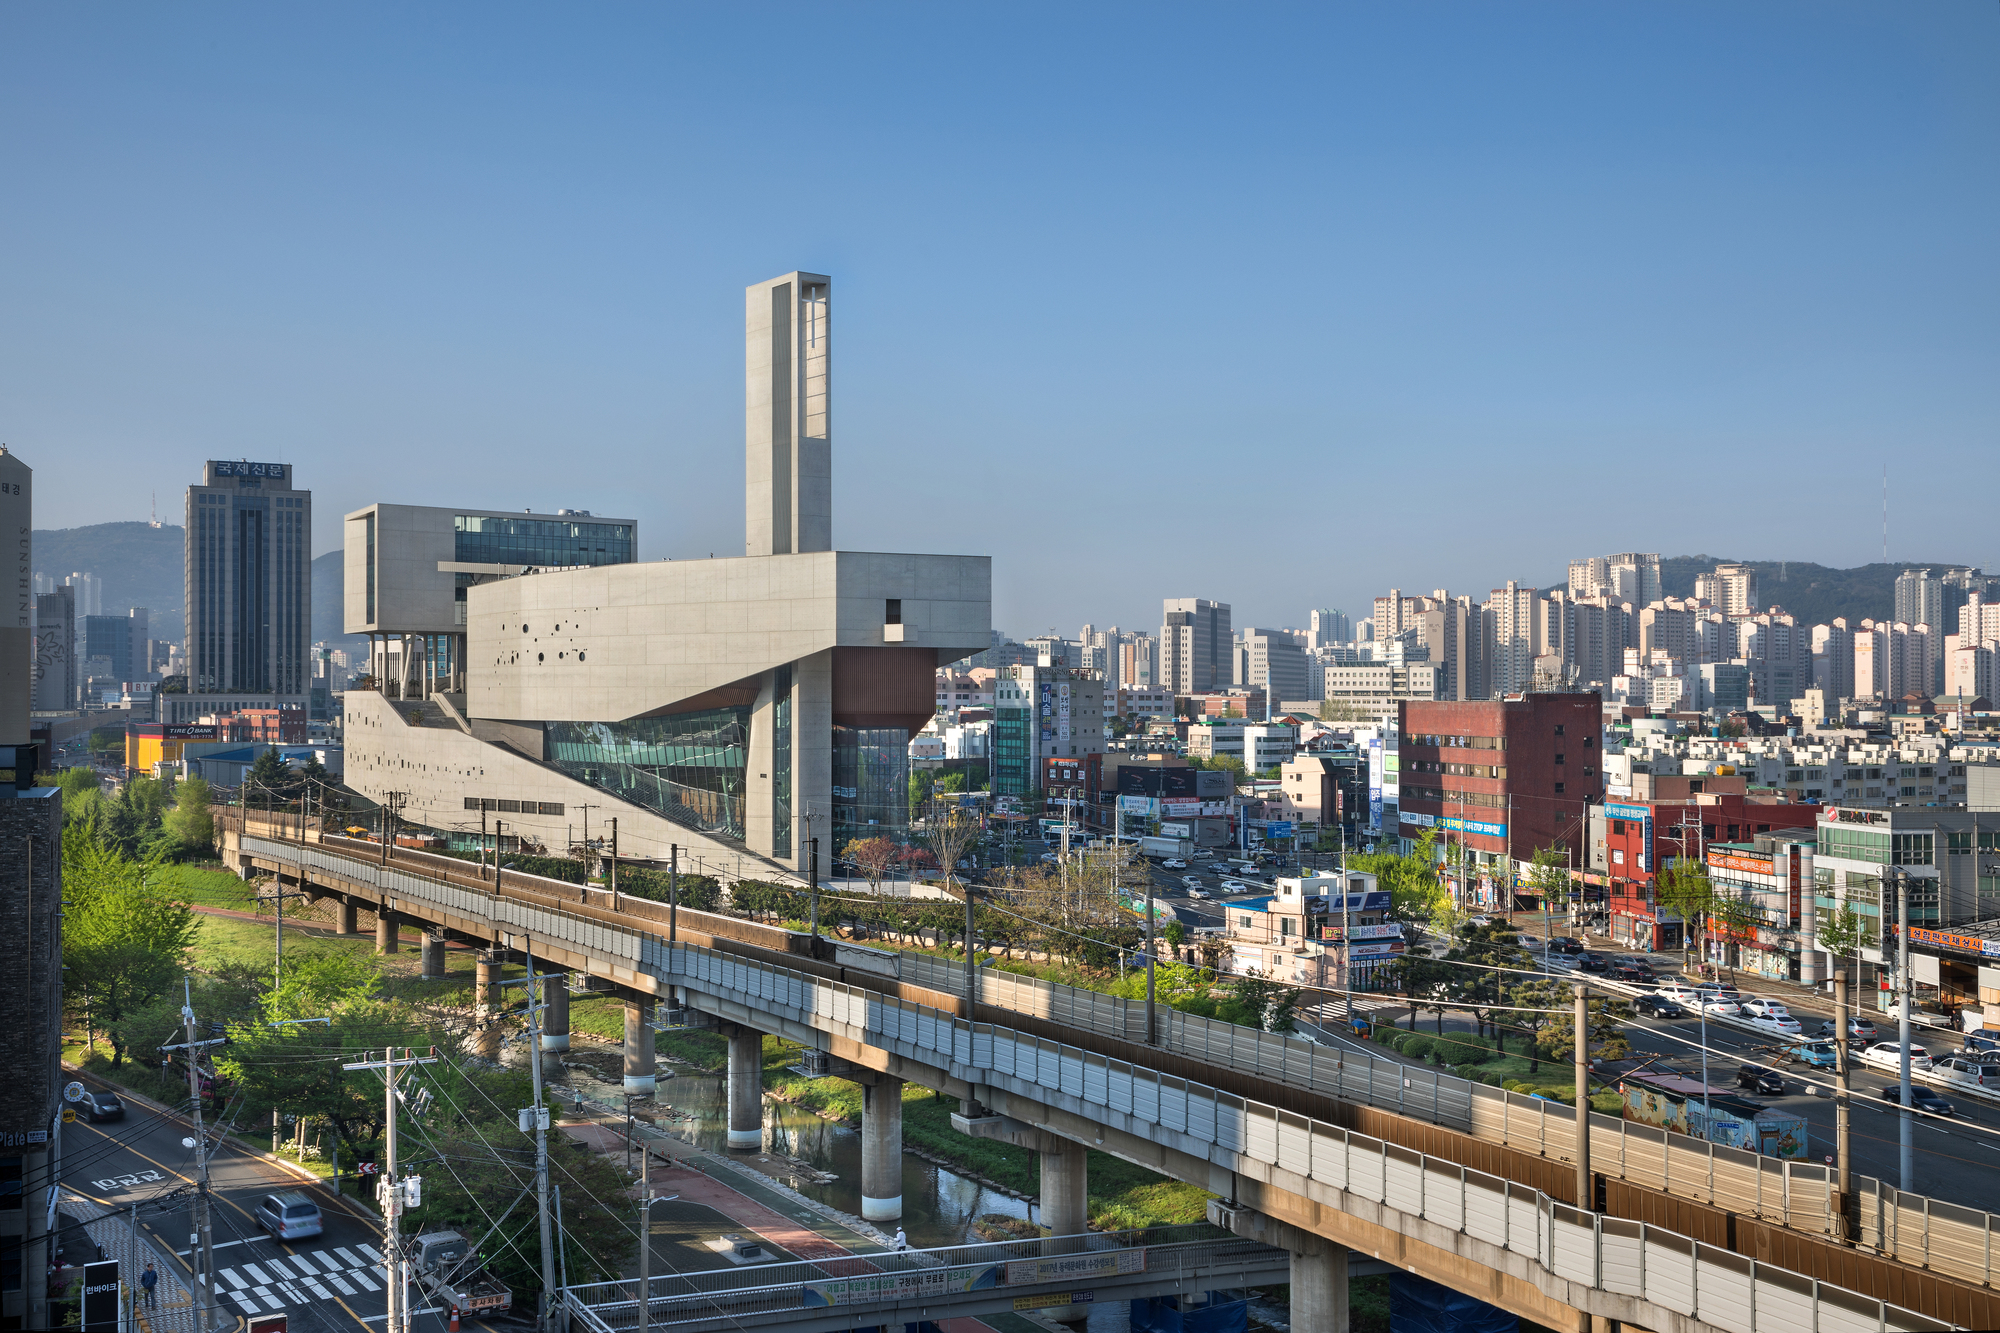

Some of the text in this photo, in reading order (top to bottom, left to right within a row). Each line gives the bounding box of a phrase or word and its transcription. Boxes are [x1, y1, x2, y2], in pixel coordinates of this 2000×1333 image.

[217, 462, 282, 477] 국제신문
[19, 527, 29, 626] SUNSHINE
[1042, 692, 1051, 716] 마술
[1325, 928, 1341, 938] 할인
[63, 1111, 75, 1119] Max
[1039, 1262, 1058, 1273] 2017년
[926, 1273, 944, 1284] 무료로
[86, 1283, 117, 1295] 런바이크
[471, 1296, 502, 1307] 공사차량
